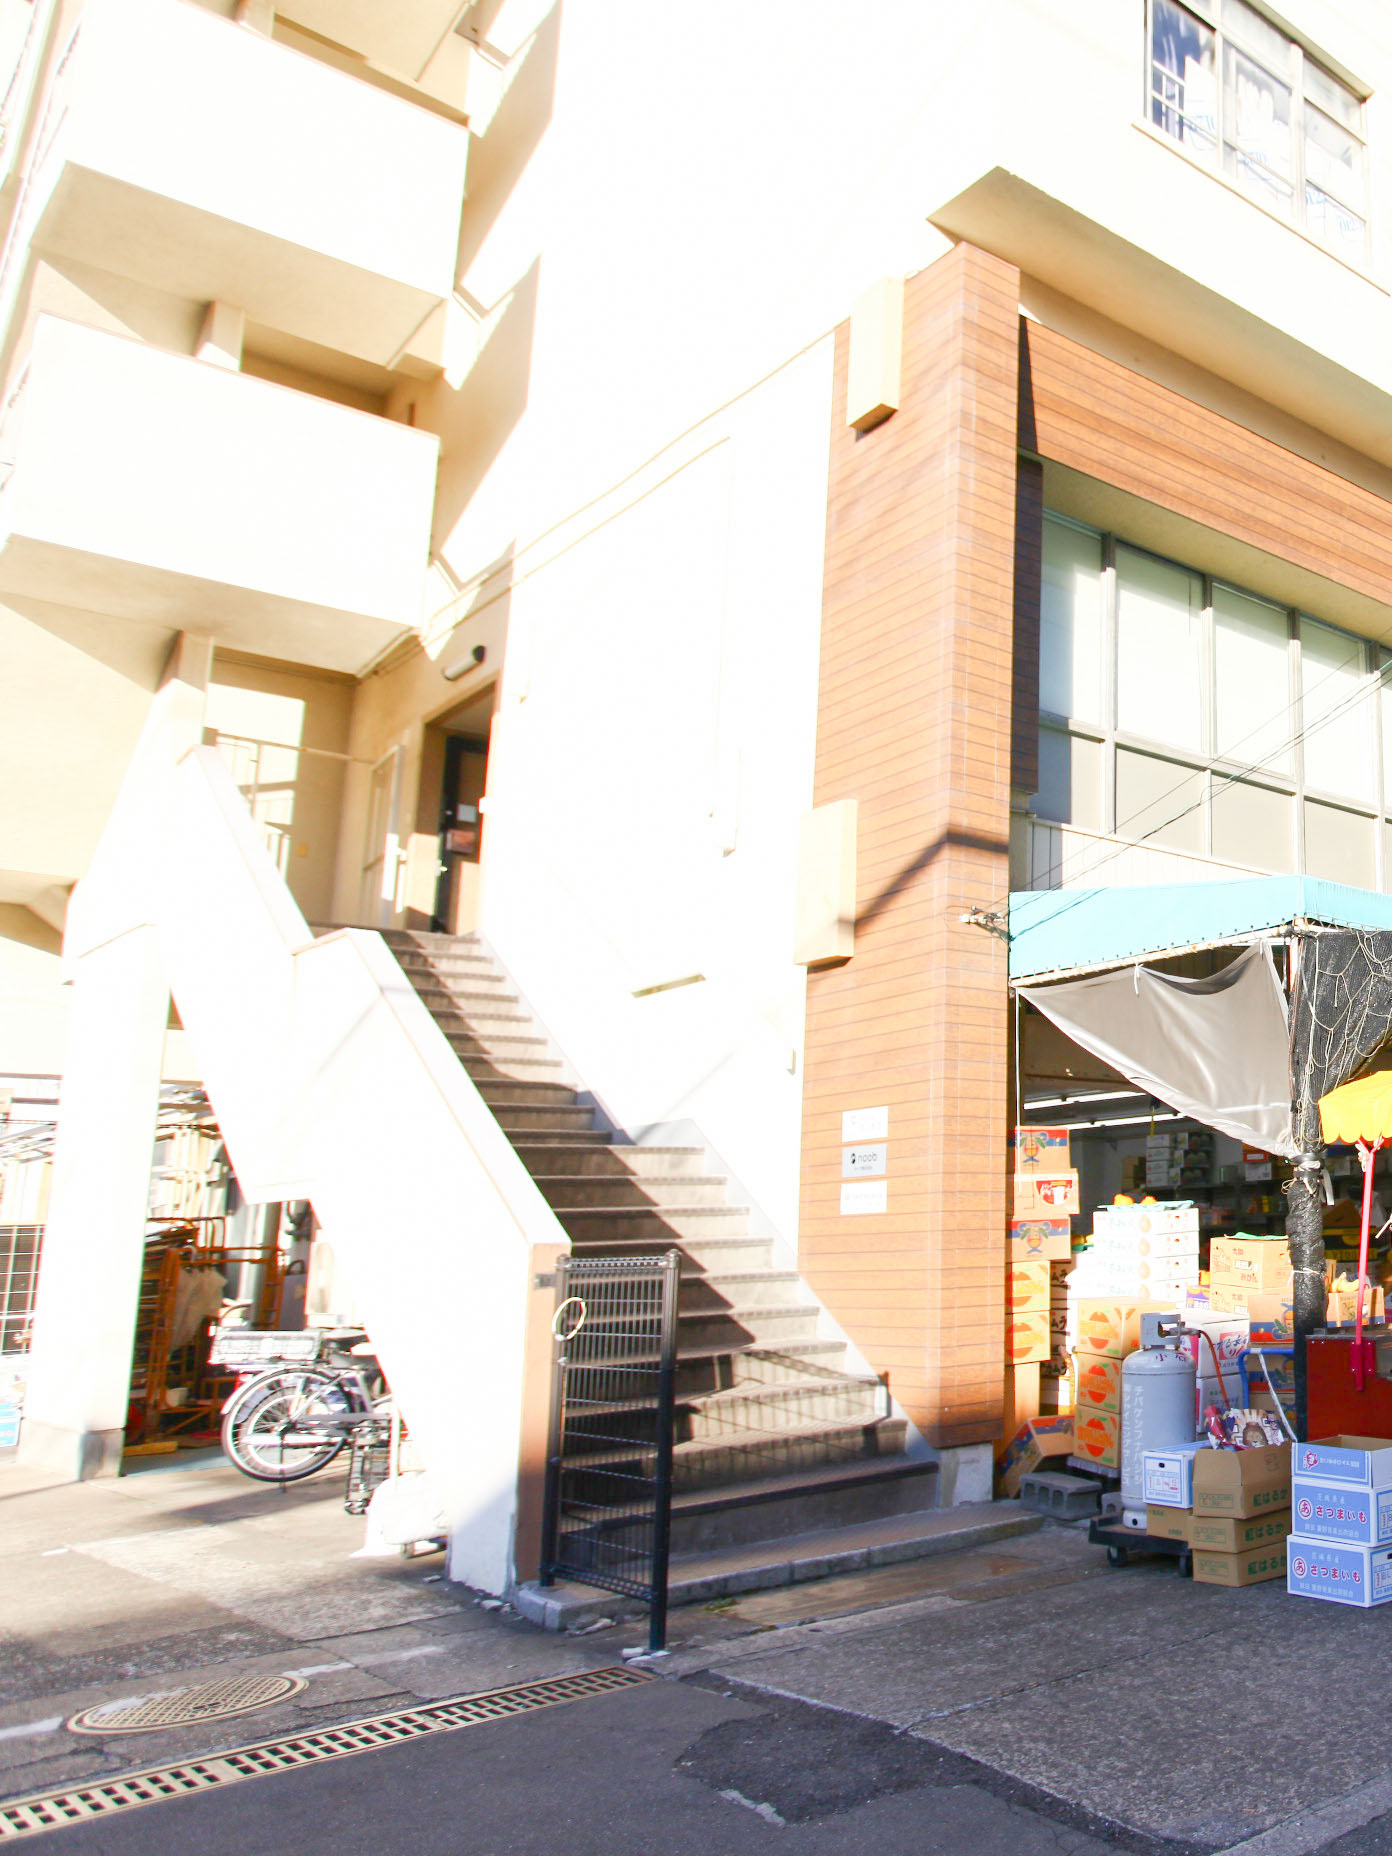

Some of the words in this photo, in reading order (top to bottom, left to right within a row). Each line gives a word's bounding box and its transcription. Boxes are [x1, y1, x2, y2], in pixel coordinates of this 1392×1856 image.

[1316, 1506, 1366, 1523] さつまいも
[1310, 1564, 1361, 1583] さつまいも
